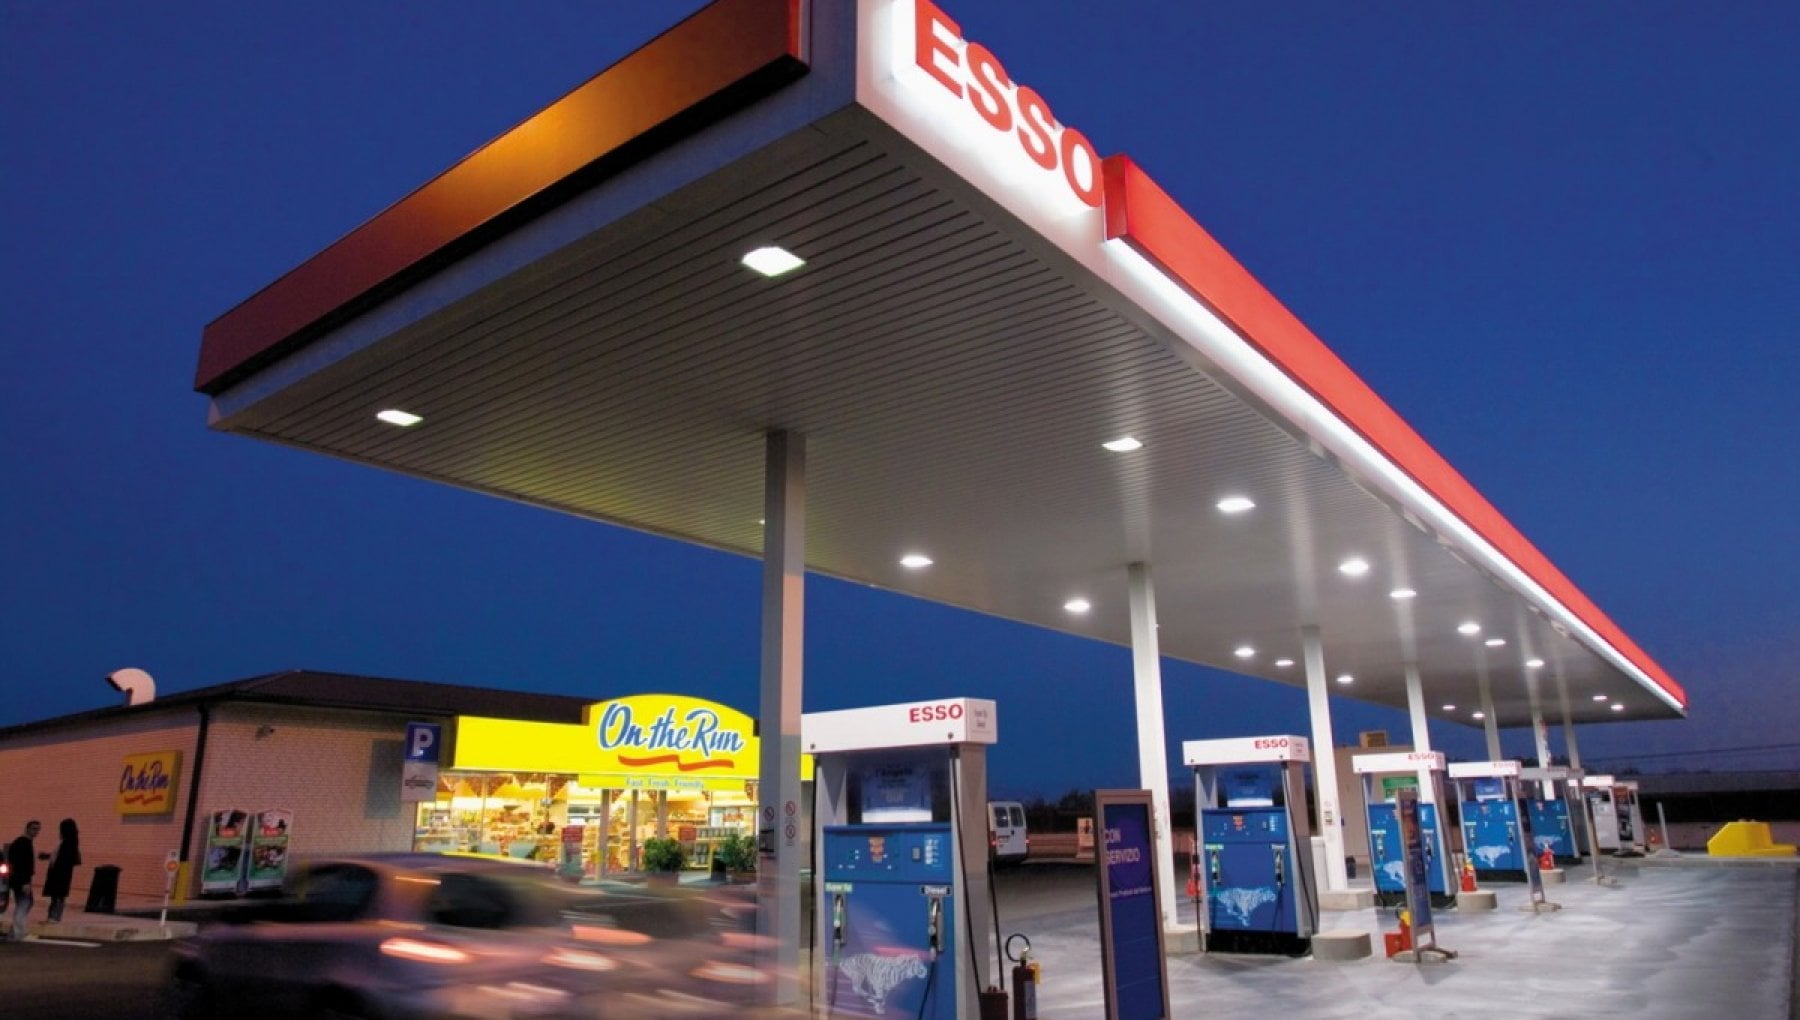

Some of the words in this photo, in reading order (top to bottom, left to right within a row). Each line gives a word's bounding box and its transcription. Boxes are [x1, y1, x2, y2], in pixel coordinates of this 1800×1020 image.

[915, 0, 1104, 208] ESSO
[909, 703, 964, 724] ESSO
[411, 728, 435, 757] P
[600, 702, 649, 749] On
[648, 707, 690, 750] the
[686, 708, 745, 757] Run
[1254, 738, 1289, 750] ESSO
